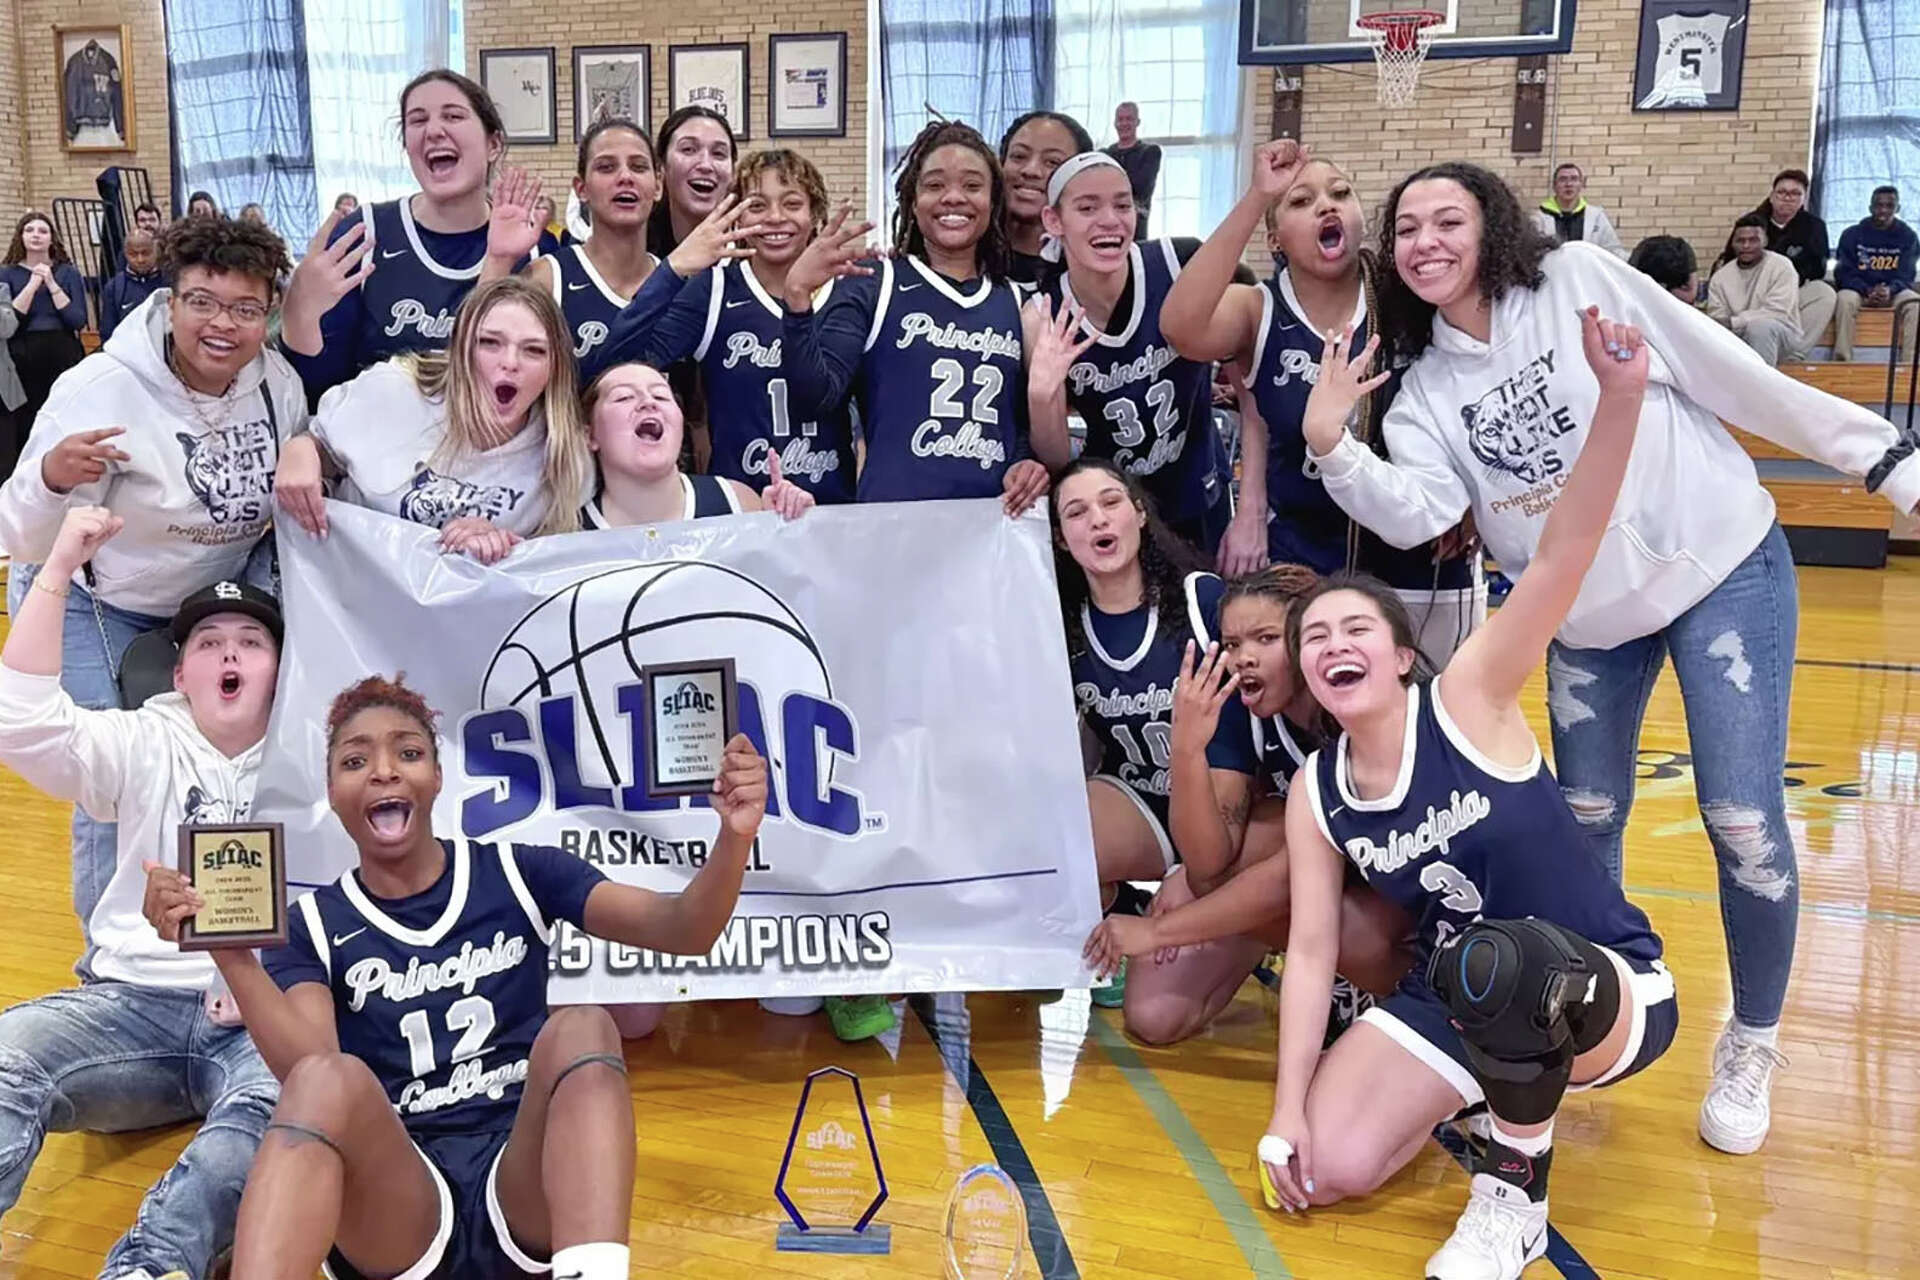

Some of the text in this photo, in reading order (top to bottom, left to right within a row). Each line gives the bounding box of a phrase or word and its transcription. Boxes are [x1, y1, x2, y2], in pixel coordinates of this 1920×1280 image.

[1681, 48, 1702, 76] 5
[896, 313, 1021, 361] Principia
[930, 358, 1004, 424] 22
[1497, 349, 1556, 404] THEY
[1103, 379, 1180, 447] 32
[911, 419, 1006, 469] College
[1490, 481, 1555, 515] Principia
[663, 691, 716, 715] SLIAC
[203, 849, 262, 870] SLIAC
[1344, 790, 1490, 882] Principia
[1420, 860, 1483, 912] 3
[345, 931, 528, 1013] Principia
[400, 995, 496, 1077] 12
[393, 1058, 529, 1114] College
